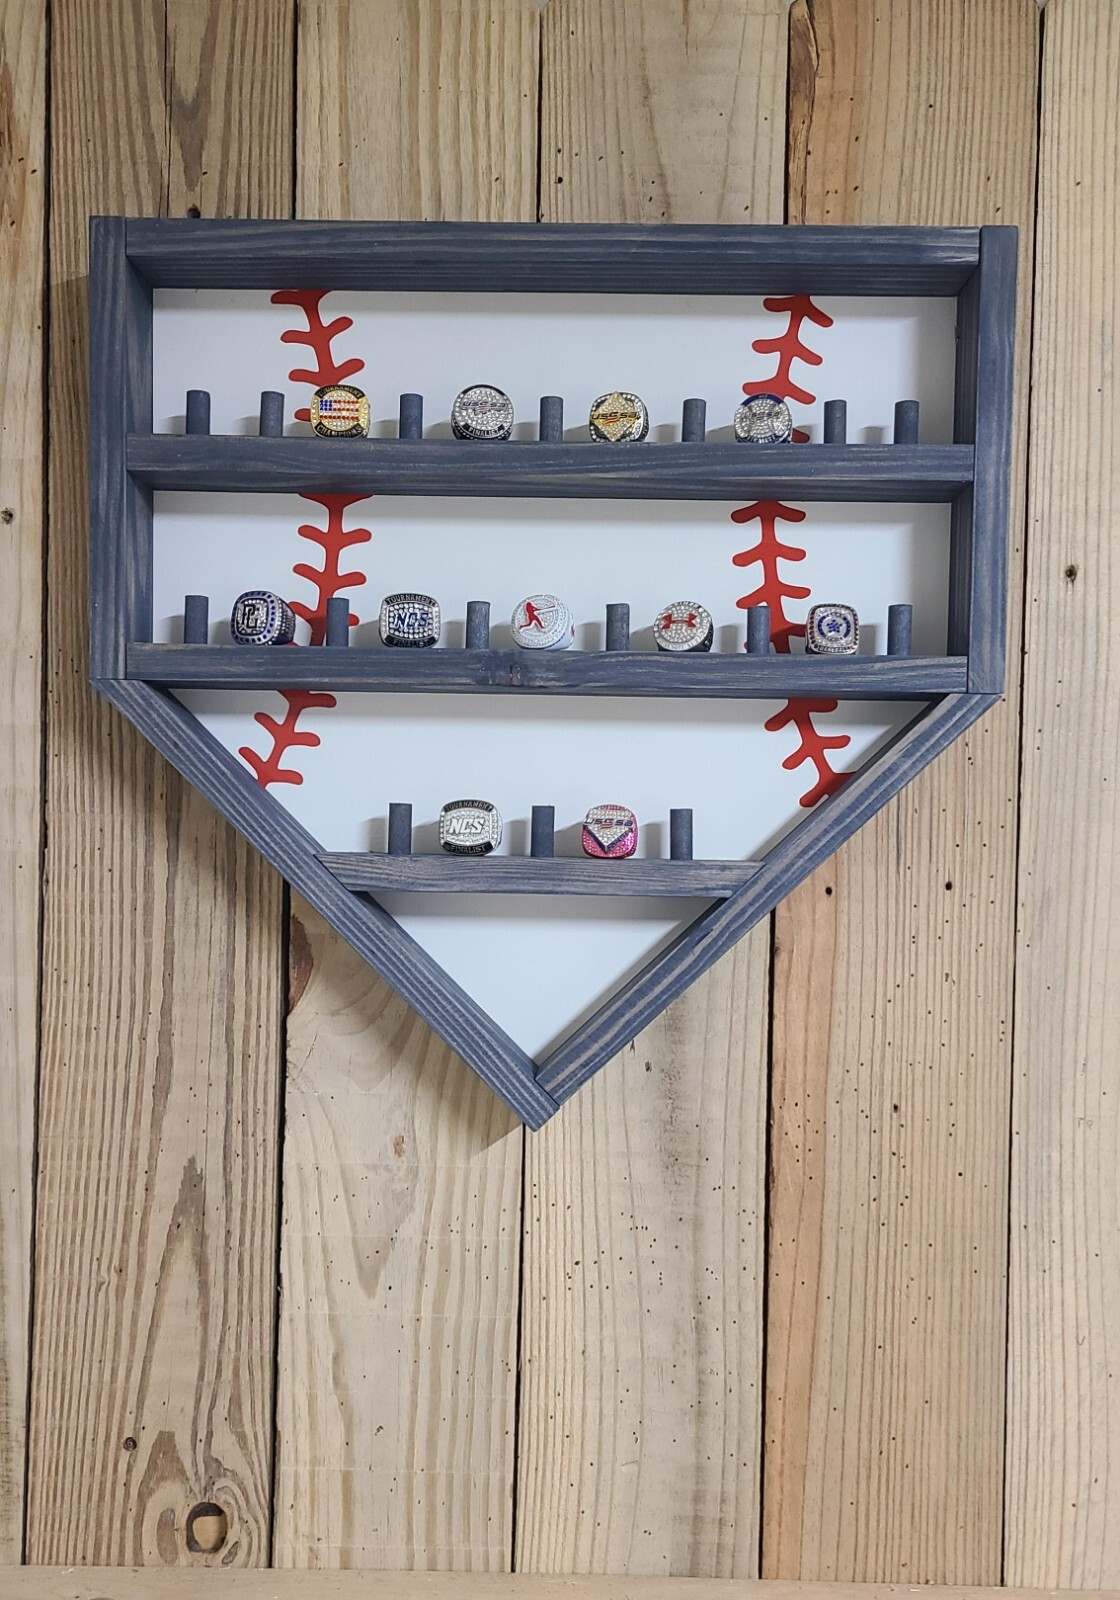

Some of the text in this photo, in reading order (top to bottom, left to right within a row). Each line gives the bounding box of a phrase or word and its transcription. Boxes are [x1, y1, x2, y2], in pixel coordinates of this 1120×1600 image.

[385, 594, 436, 606] TOURNAMENT
[393, 611, 430, 629] NCS
[447, 817, 486, 835] NCS
[450, 843, 487, 854] FINALIST
